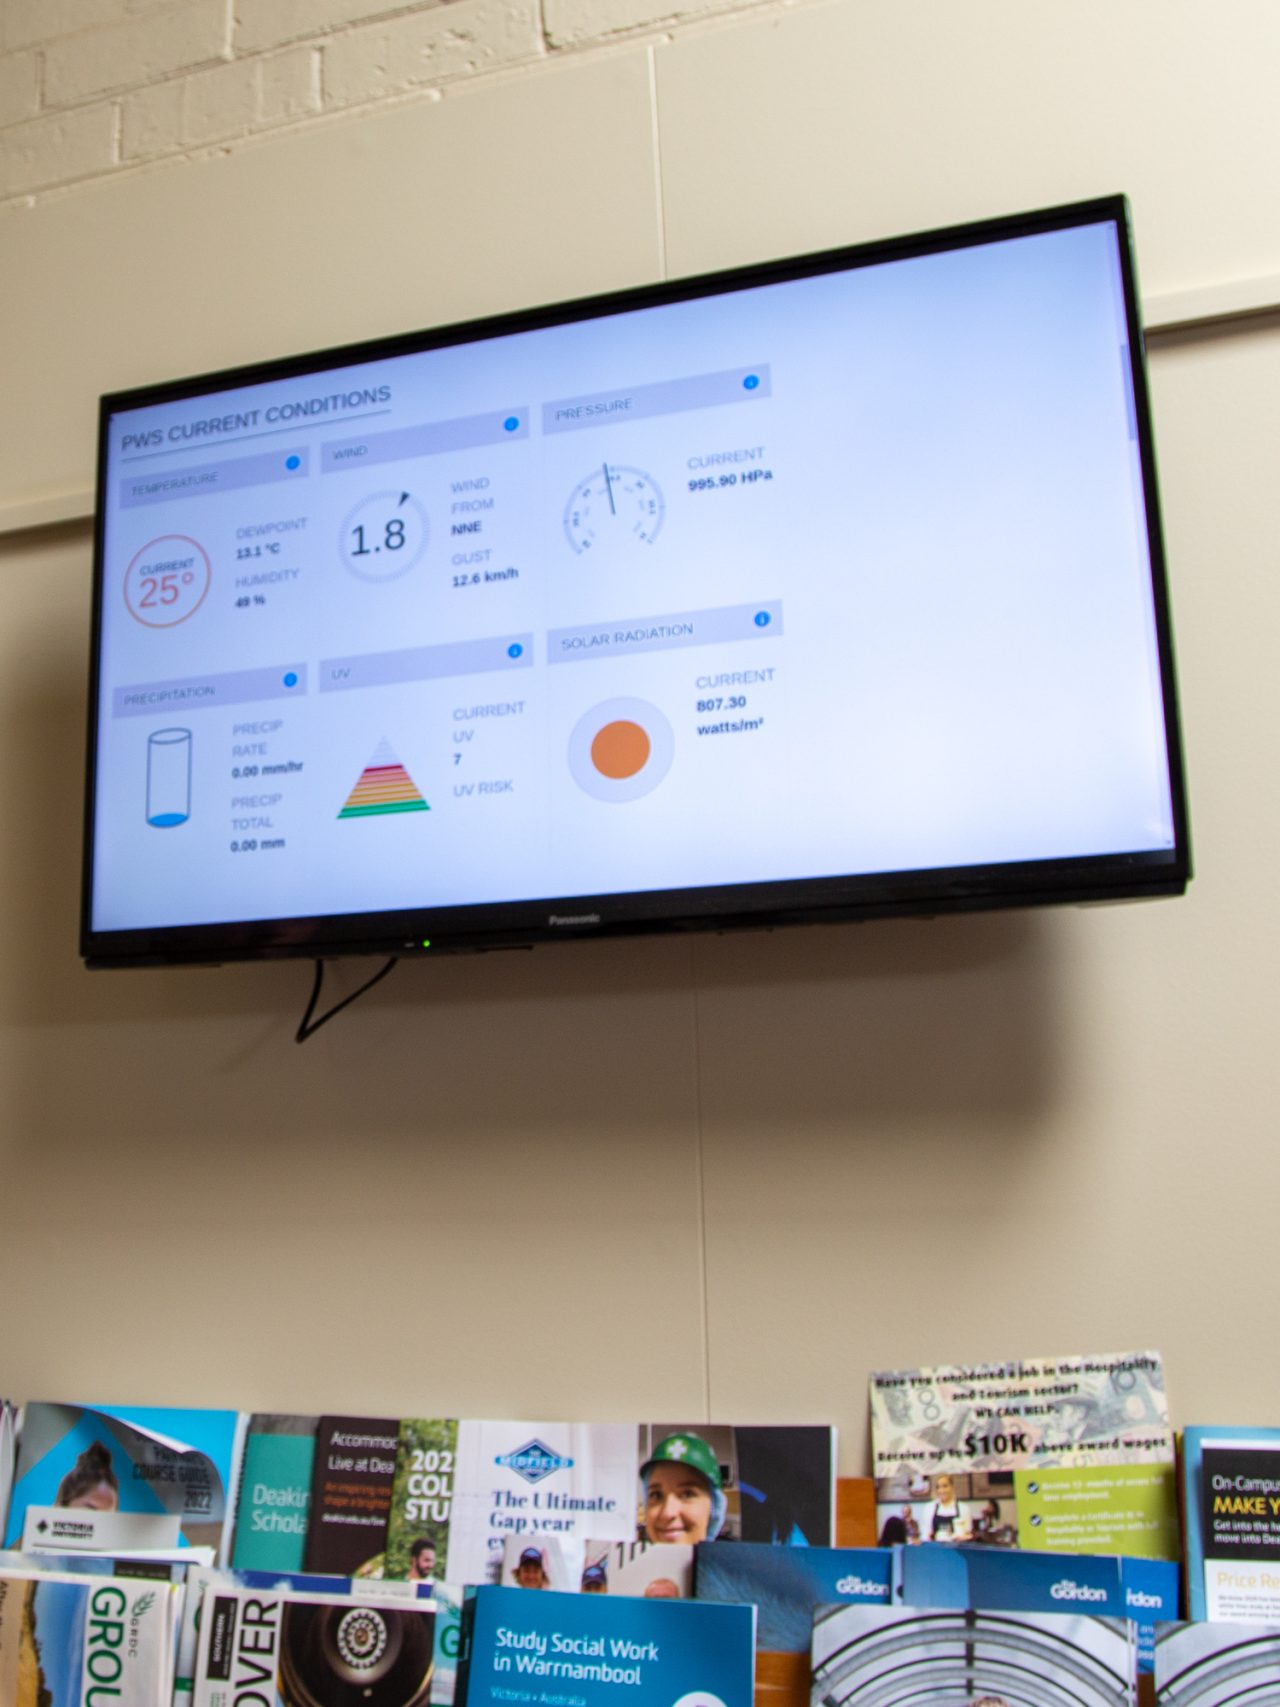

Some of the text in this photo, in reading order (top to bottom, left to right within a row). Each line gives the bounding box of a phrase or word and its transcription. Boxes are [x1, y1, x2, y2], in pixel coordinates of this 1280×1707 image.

[121, 385, 392, 451] PWS CURRENT CONDITIONS
[555, 398, 633, 421] PRESSURE
[333, 445, 369, 460] WIND
[687, 446, 766, 470] CURRENT
[132, 472, 219, 496] TEMPERATURE
[450, 477, 490, 493] WIND
[688, 468, 774, 492] 995.90 HPa
[451, 498, 495, 514] FROM
[236, 517, 308, 540] DEWPOINT
[350, 519, 406, 557] 1.8
[451, 520, 482, 536] NNE
[452, 548, 492, 565] GUST
[139, 557, 195, 577] CURRENT
[235, 568, 300, 588] HUMIDITY
[452, 567, 519, 588] 12.6 km/h
[561, 623, 694, 651] SOLAR RADIATION
[331, 668, 350, 680] UV
[695, 667, 776, 690] CURRENT
[123, 685, 216, 707] PRECIPITATION
[697, 695, 746, 713] 807.30
[453, 701, 526, 721] CURRENT
[232, 719, 284, 737] PRECIP
[453, 729, 475, 744] UV
[232, 742, 267, 758] RATE
[453, 753, 462, 766] 7
[453, 779, 514, 798] UV RISK
[231, 793, 283, 810] PRECIP
[231, 816, 274, 831] TOTAL
[964, 1432, 1027, 1459] $10K
[328, 1454, 354, 1471] Live
[354, 1458, 368, 1472] at
[411, 1449, 457, 1472] 202
[407, 1474, 452, 1498] COL
[1211, 1474, 1280, 1495] On-Campu
[404, 1498, 450, 1523] STU
[492, 1490, 616, 1512] The Ultimate
[1213, 1495, 1267, 1516] MAKE
[489, 1511, 575, 1535] Gap year
[1213, 1519, 1231, 1532] Get
[1232, 1520, 1252, 1532] into
[1253, 1520, 1269, 1532] the
[1214, 1534, 1240, 1544] move
[1242, 1533, 1261, 1545] into
[836, 1578, 890, 1596] Gordon
[1217, 1572, 1257, 1588] Price
[1050, 1583, 1108, 1602] Gordon
[128, 1617, 140, 1658] GRDC
[496, 1627, 659, 1662] Study Social Work
[493, 1652, 641, 1686] in Warrnambool
[490, 1686, 531, 1702] Victoria
